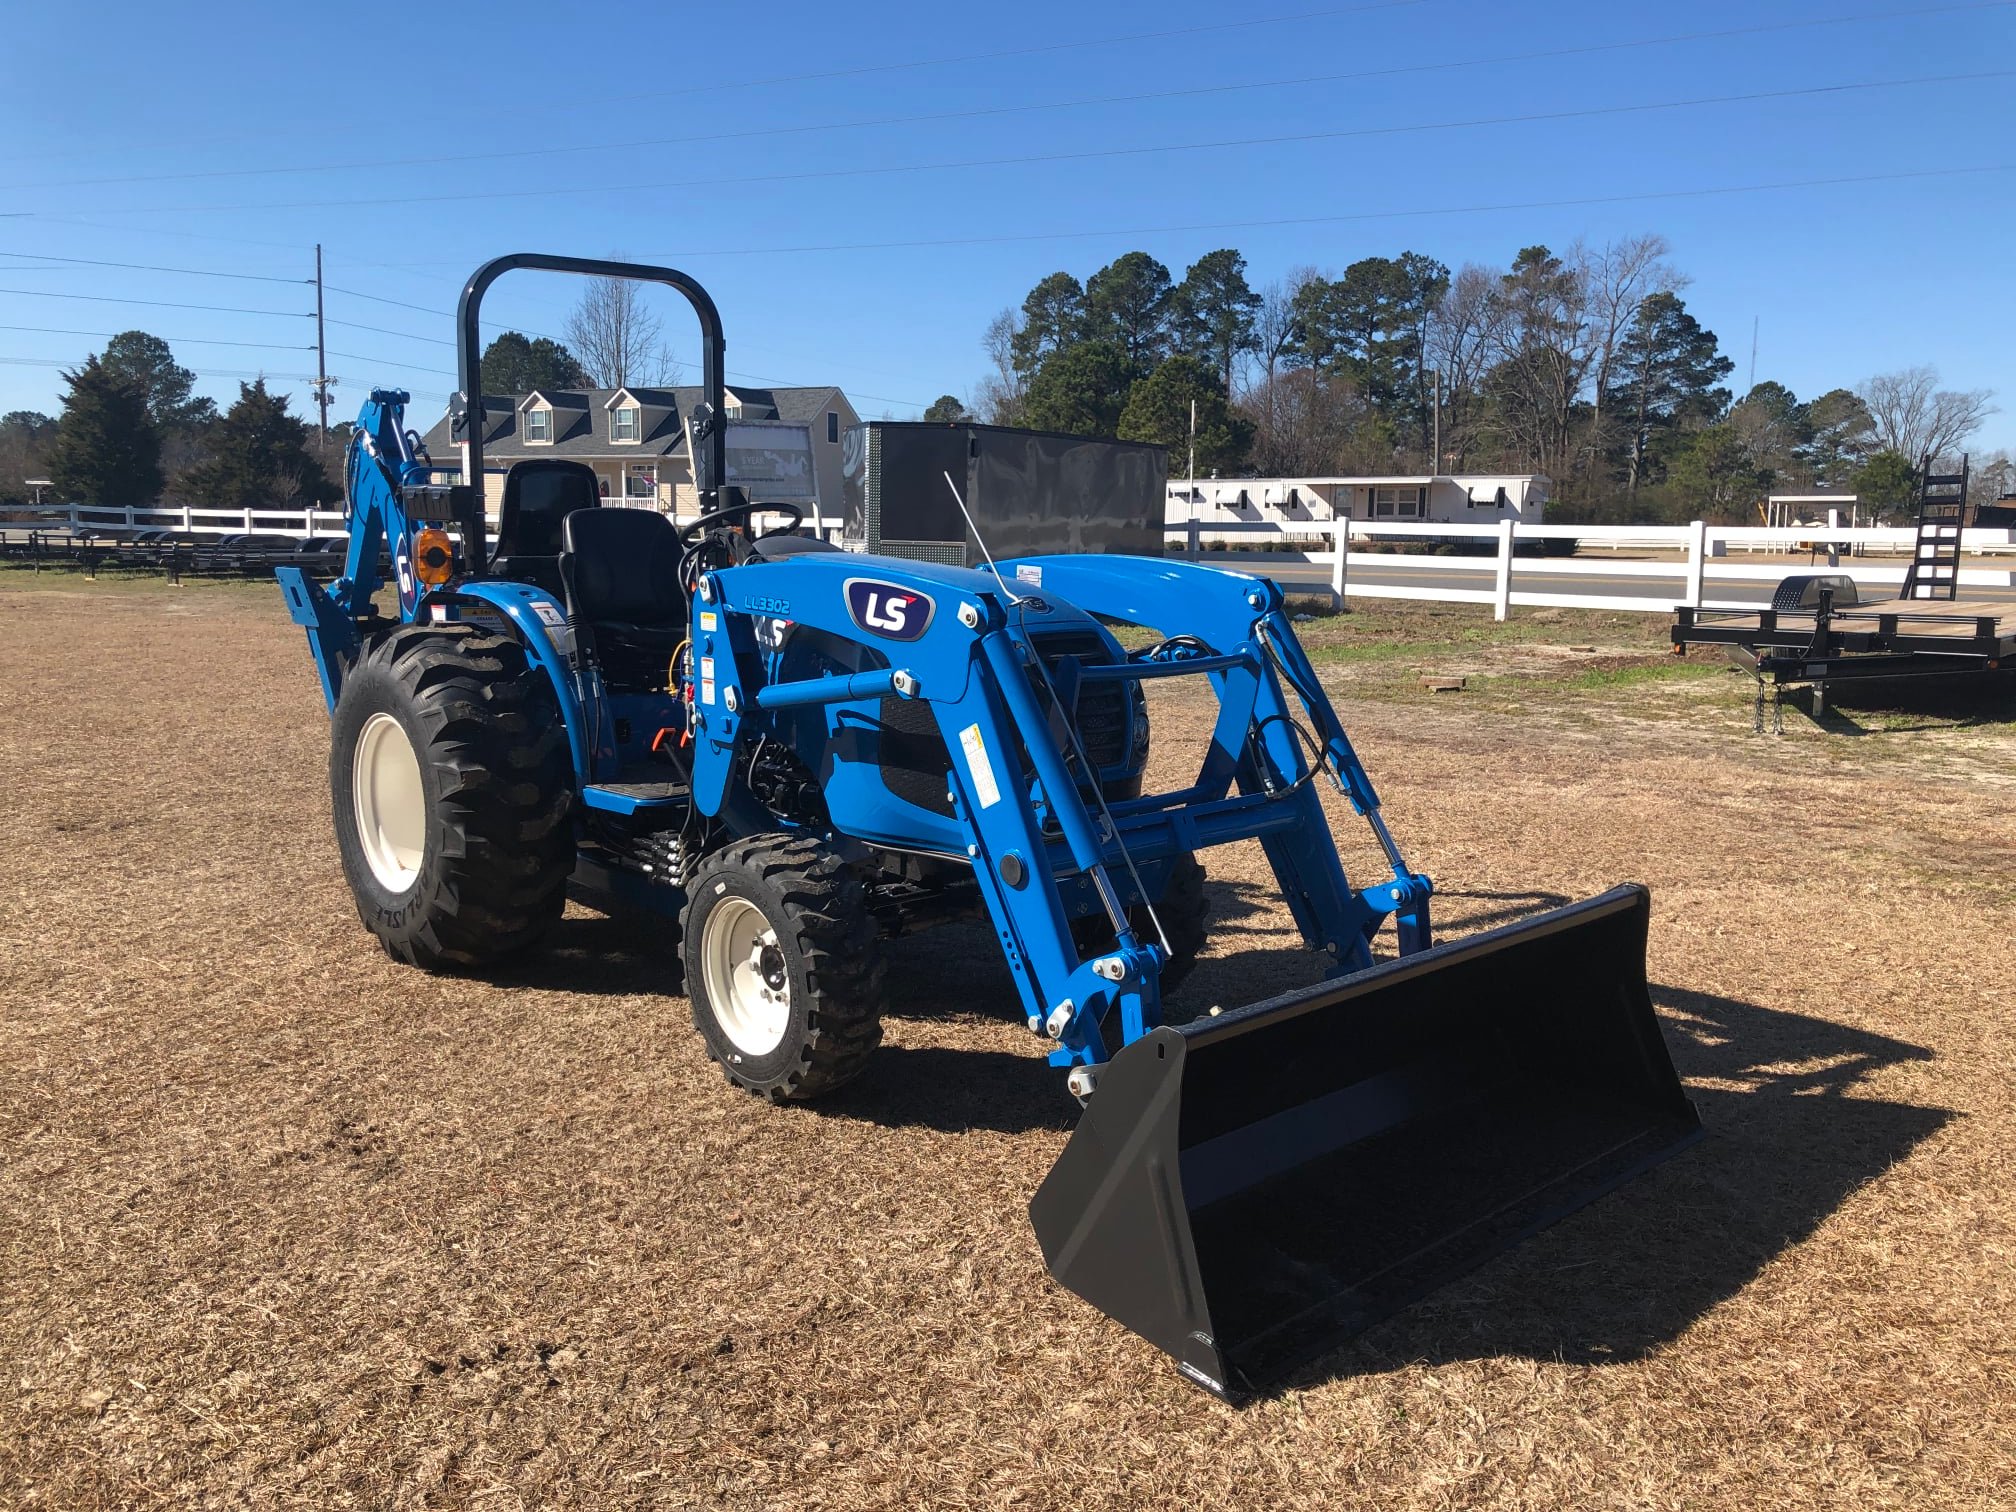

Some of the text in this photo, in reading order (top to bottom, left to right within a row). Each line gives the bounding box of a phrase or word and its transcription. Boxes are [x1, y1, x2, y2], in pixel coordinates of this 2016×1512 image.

[397, 556, 411, 593] LS
[745, 595, 790, 615] LL3302
[866, 592, 907, 632] LS
